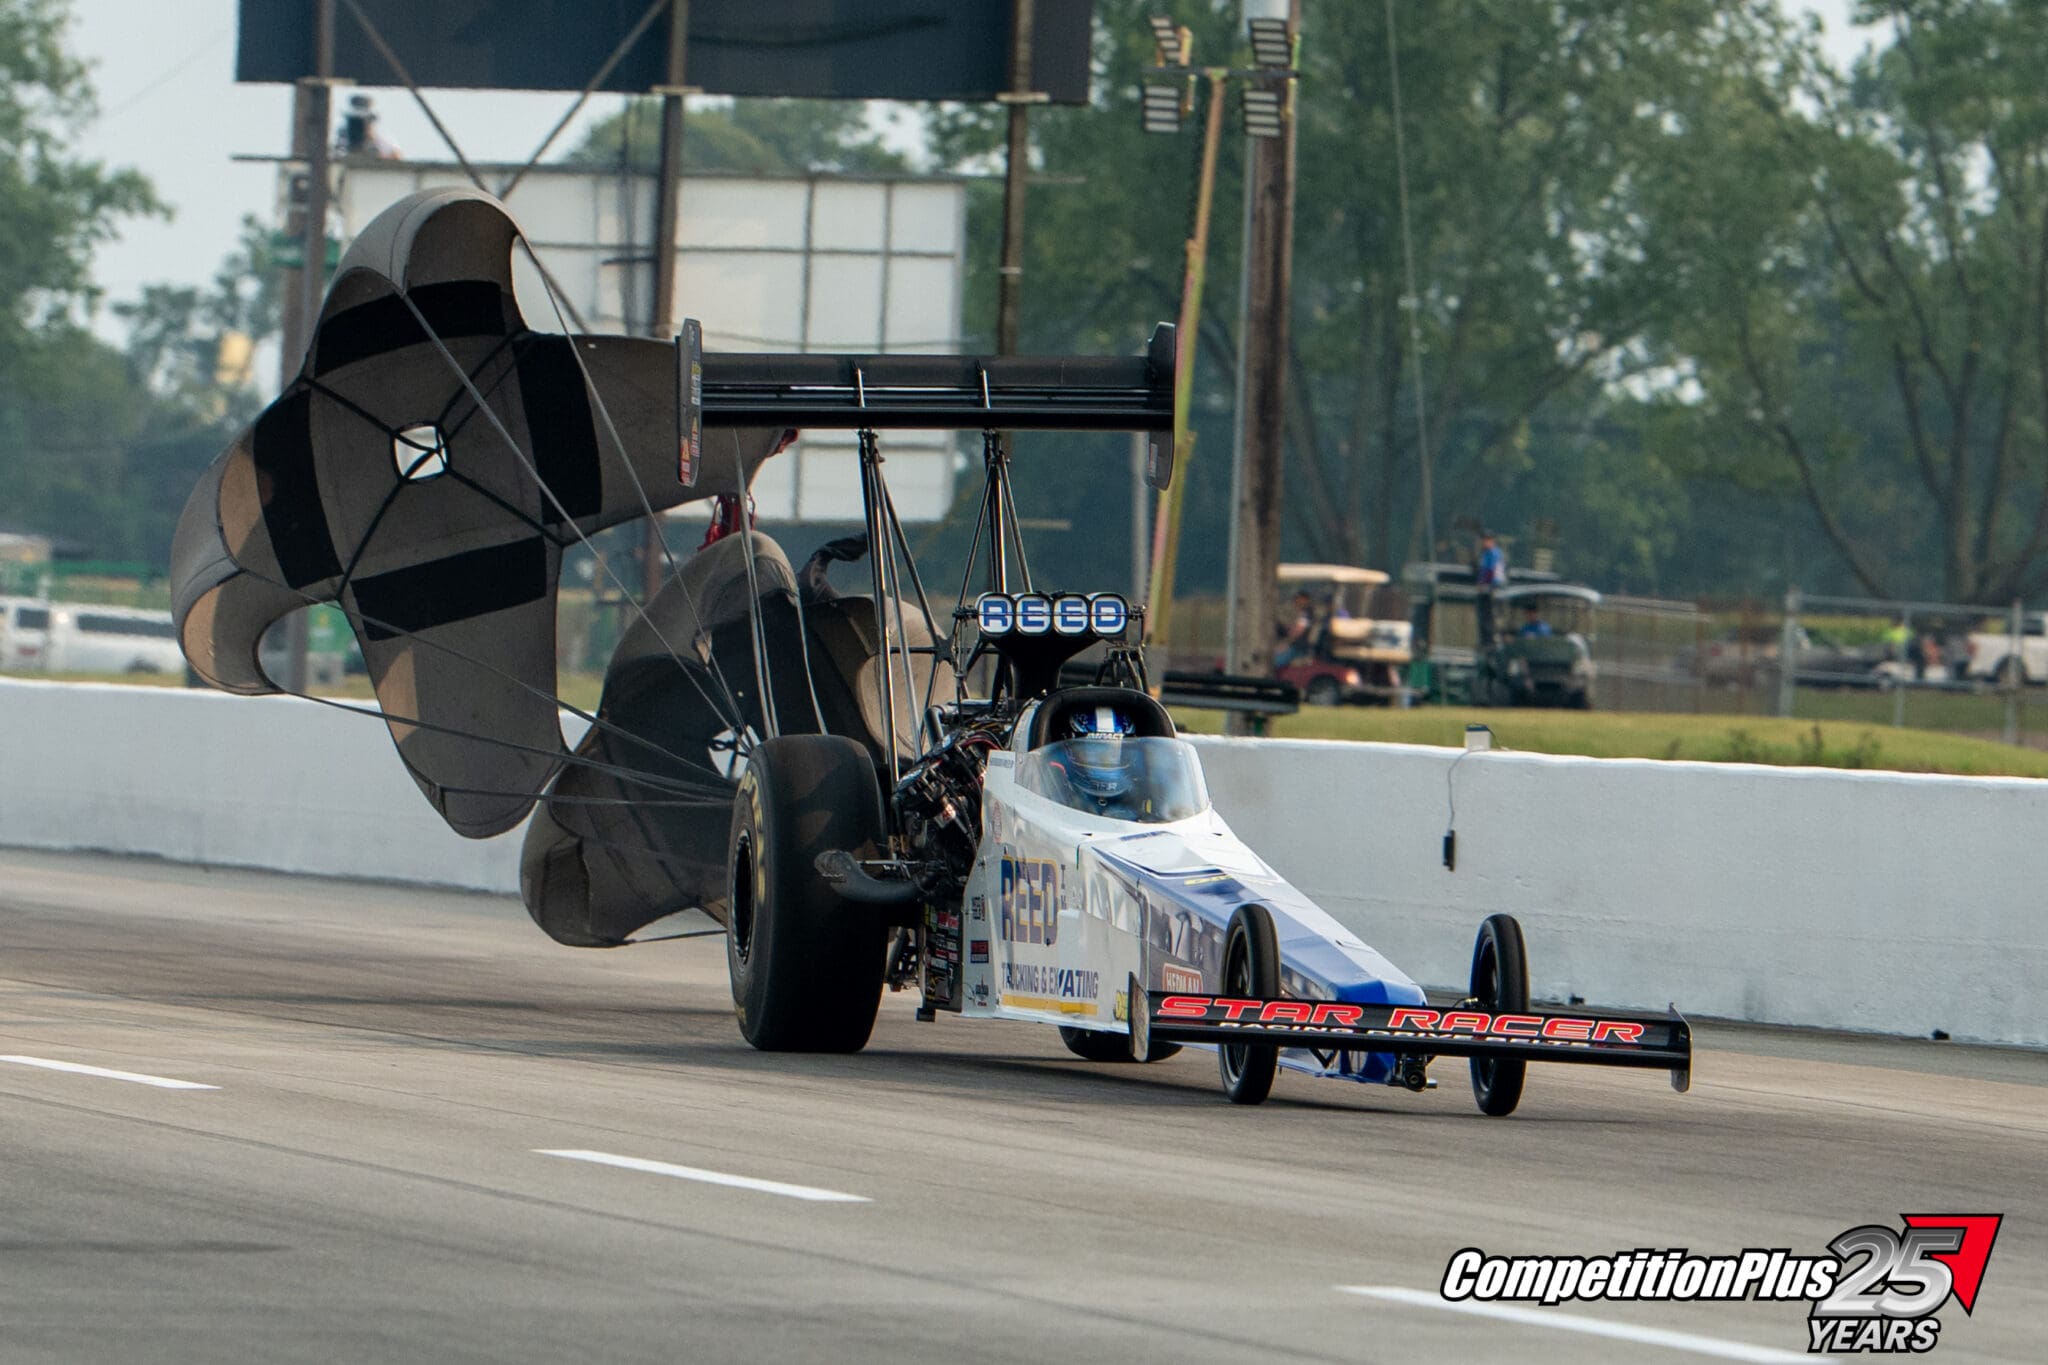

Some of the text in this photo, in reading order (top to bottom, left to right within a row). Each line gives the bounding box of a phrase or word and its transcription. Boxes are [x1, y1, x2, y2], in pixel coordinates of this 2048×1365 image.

[983, 600, 1122, 628] REED
[1001, 856, 1059, 945] REED
[1157, 996, 1364, 1026] STAR
[1387, 1008, 1645, 1043] RACER
